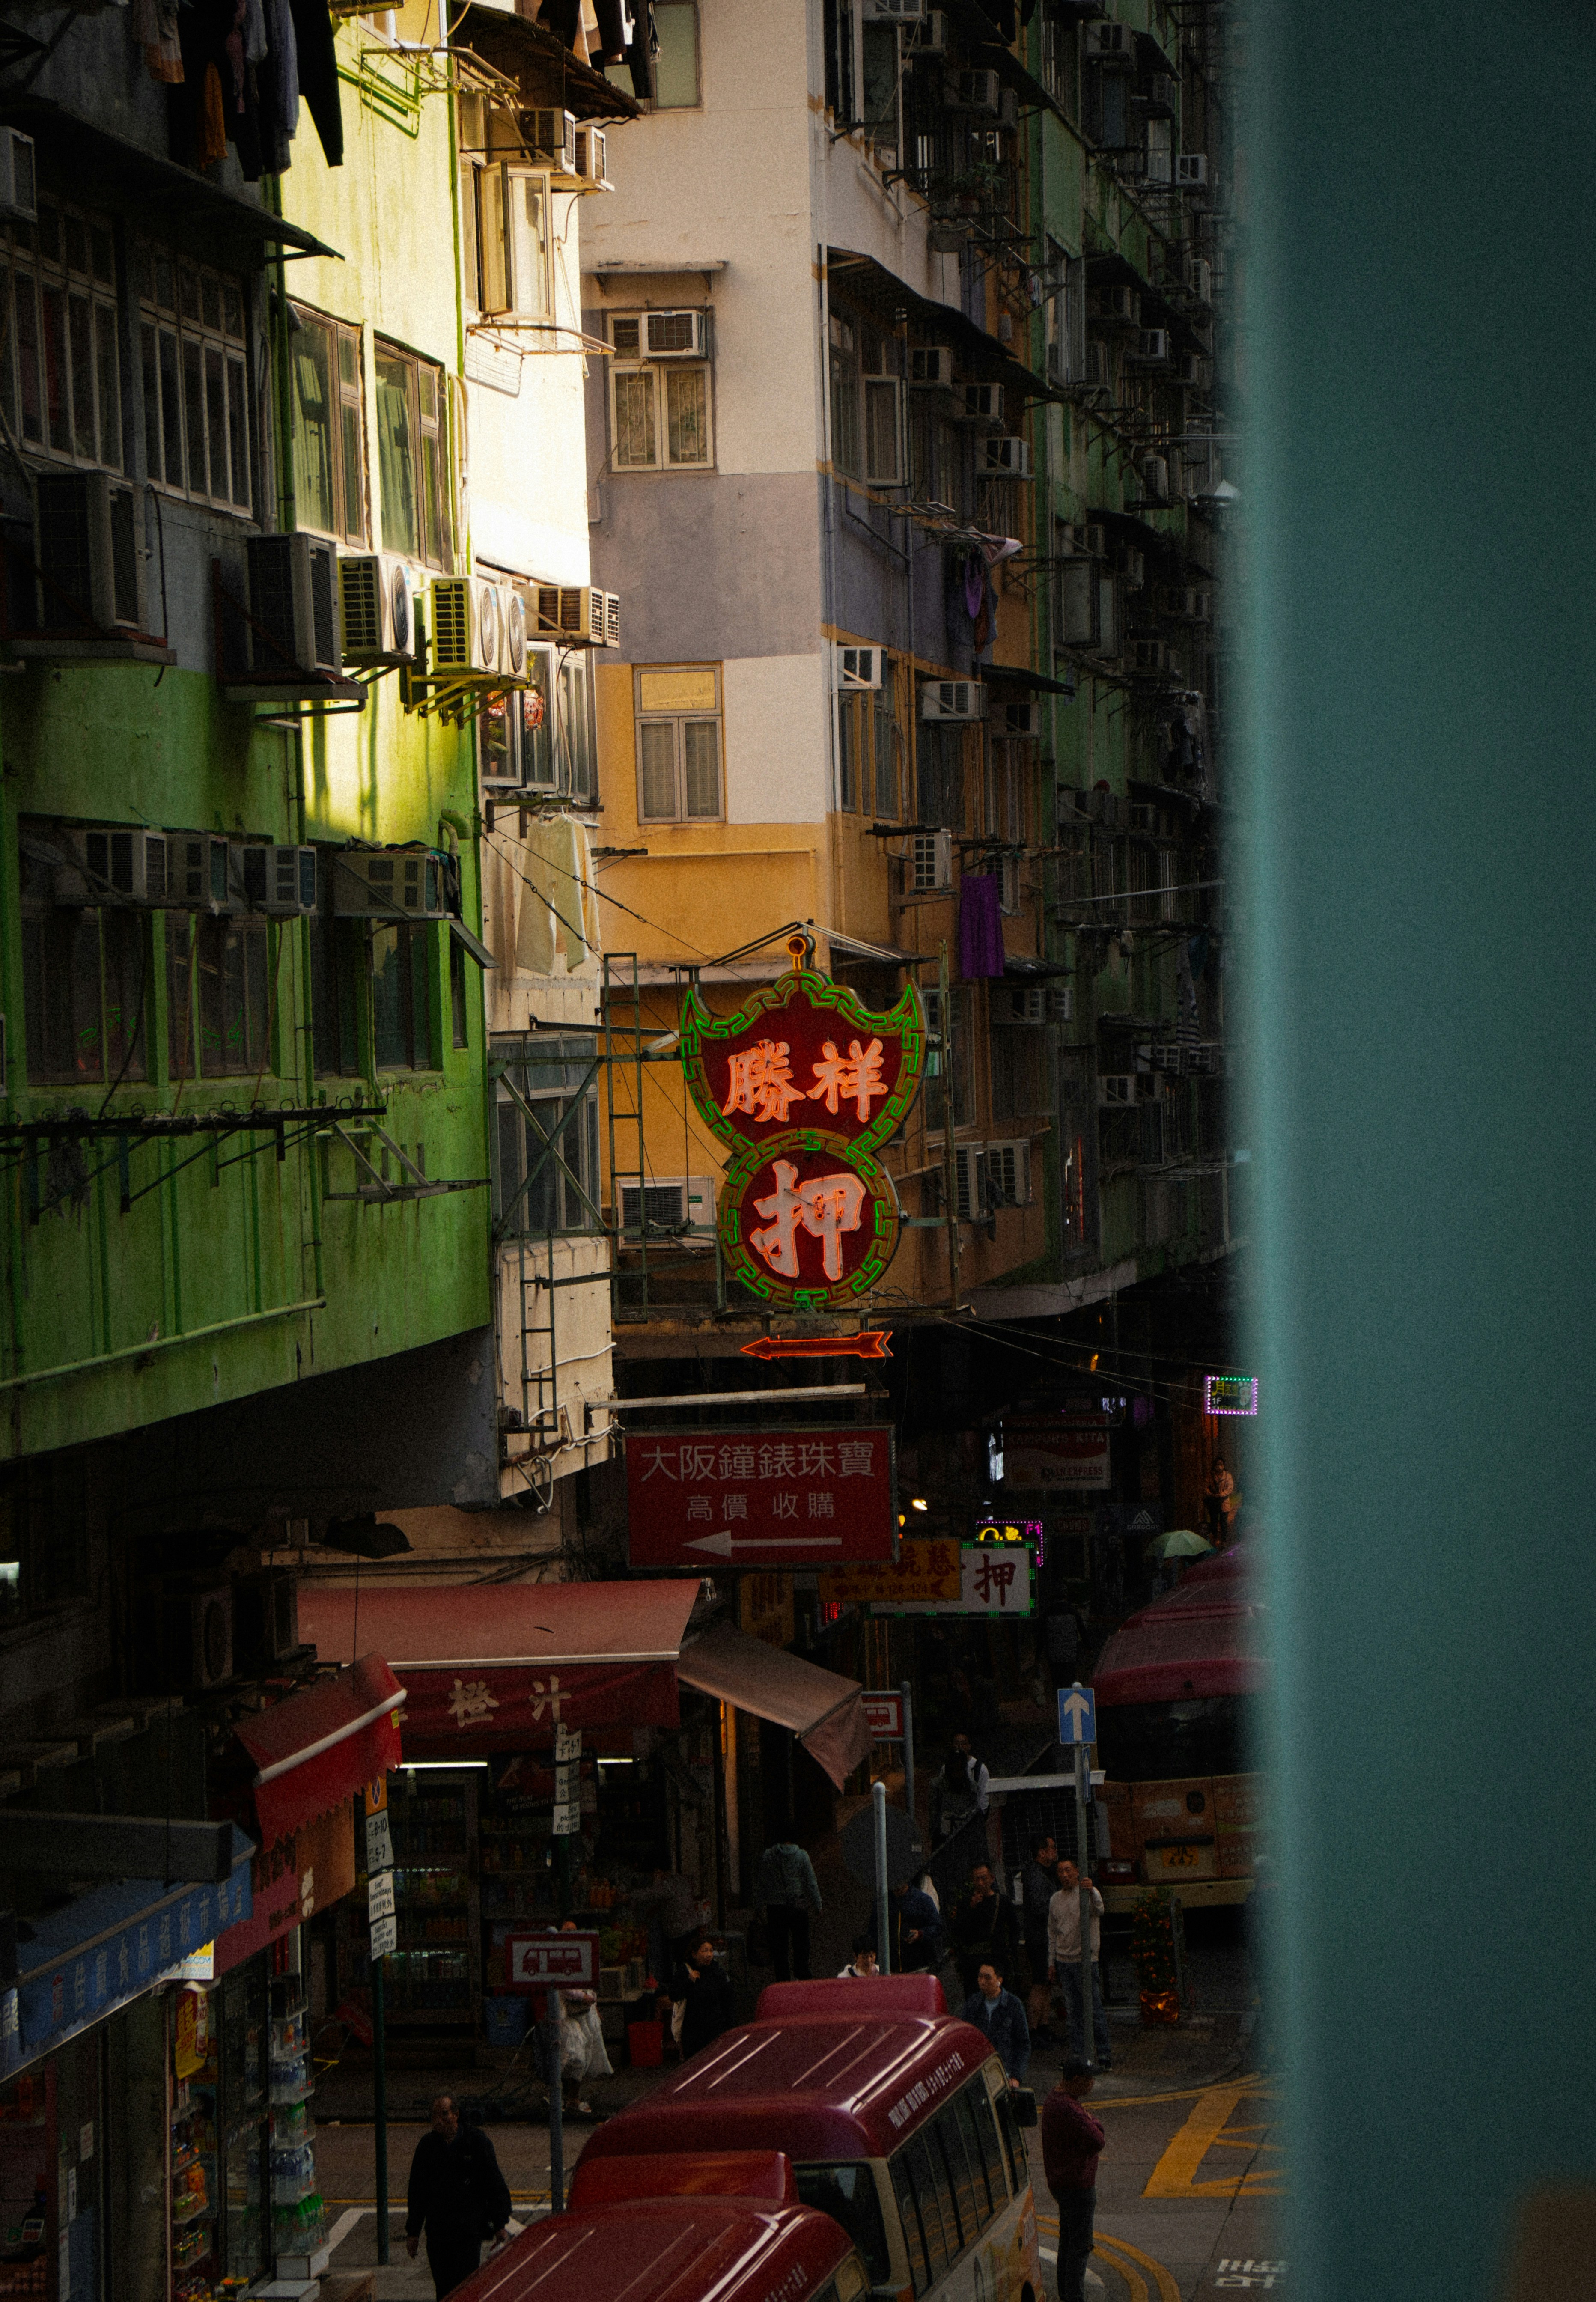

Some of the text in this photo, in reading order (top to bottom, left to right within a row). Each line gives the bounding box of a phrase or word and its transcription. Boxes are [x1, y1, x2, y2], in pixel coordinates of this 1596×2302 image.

[722, 1037, 889, 1123] 勝祥
[750, 1159, 865, 1281] 押
[1076, 1432, 1105, 1444] KITA
[640, 1441, 875, 1483] 大阪鐘錶珠寶
[1068, 1466, 1103, 1476] EXPRESS
[686, 1491, 835, 1521] 高價 收購
[974, 1554, 1016, 1607] 押
